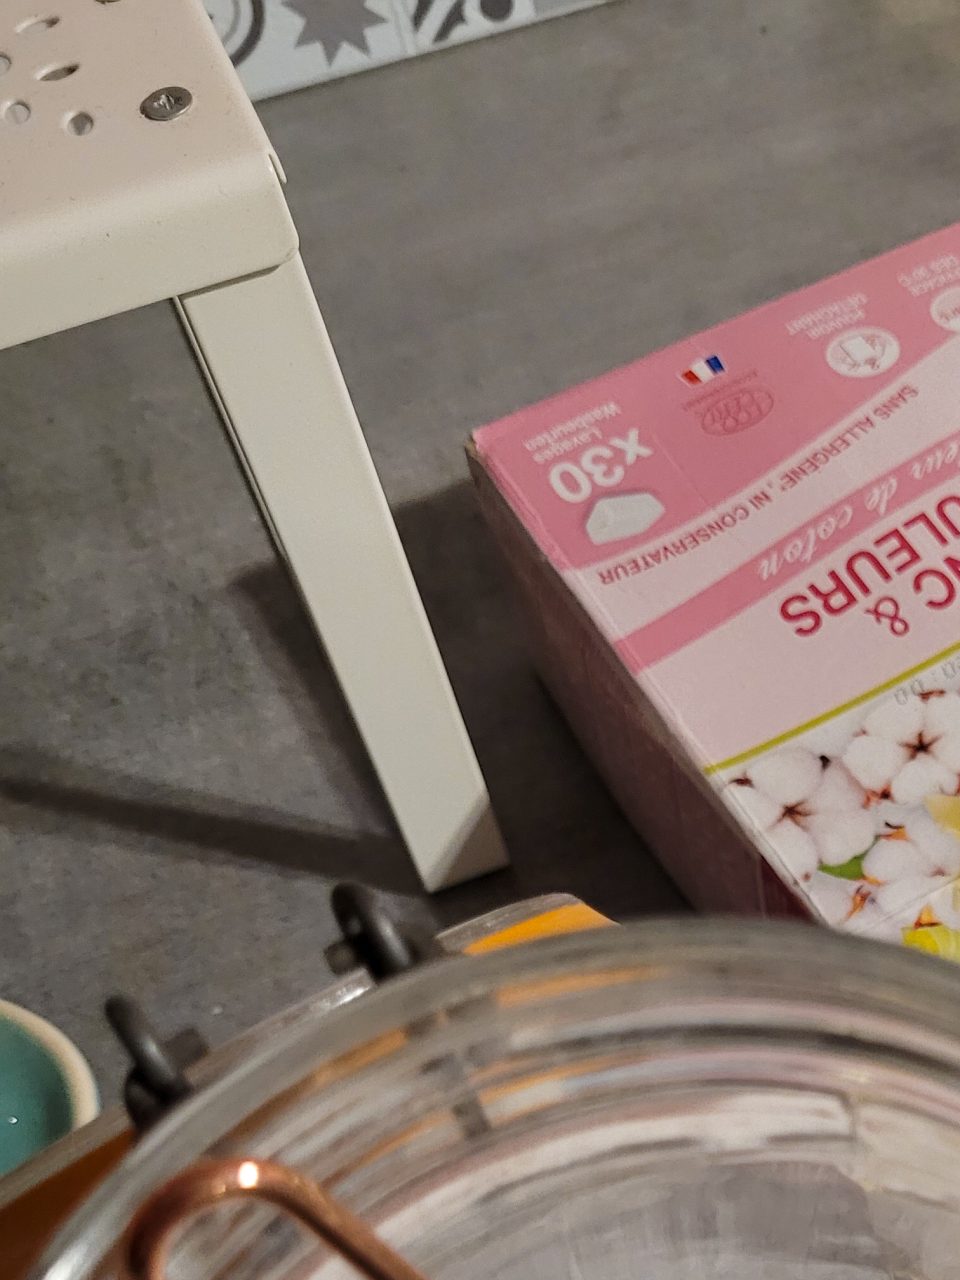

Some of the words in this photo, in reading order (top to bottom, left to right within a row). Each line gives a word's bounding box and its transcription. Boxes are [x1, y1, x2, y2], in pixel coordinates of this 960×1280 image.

[873, 384, 919, 420] SANS
[532, 426, 603, 464] Lavages
[548, 427, 653, 503] x30
[748, 490, 771, 508] NI
[865, 476, 898, 515] de
[597, 504, 750, 585] CONSERVATEUR
[756, 504, 854, 581] coton
[864, 595, 910, 637] &
